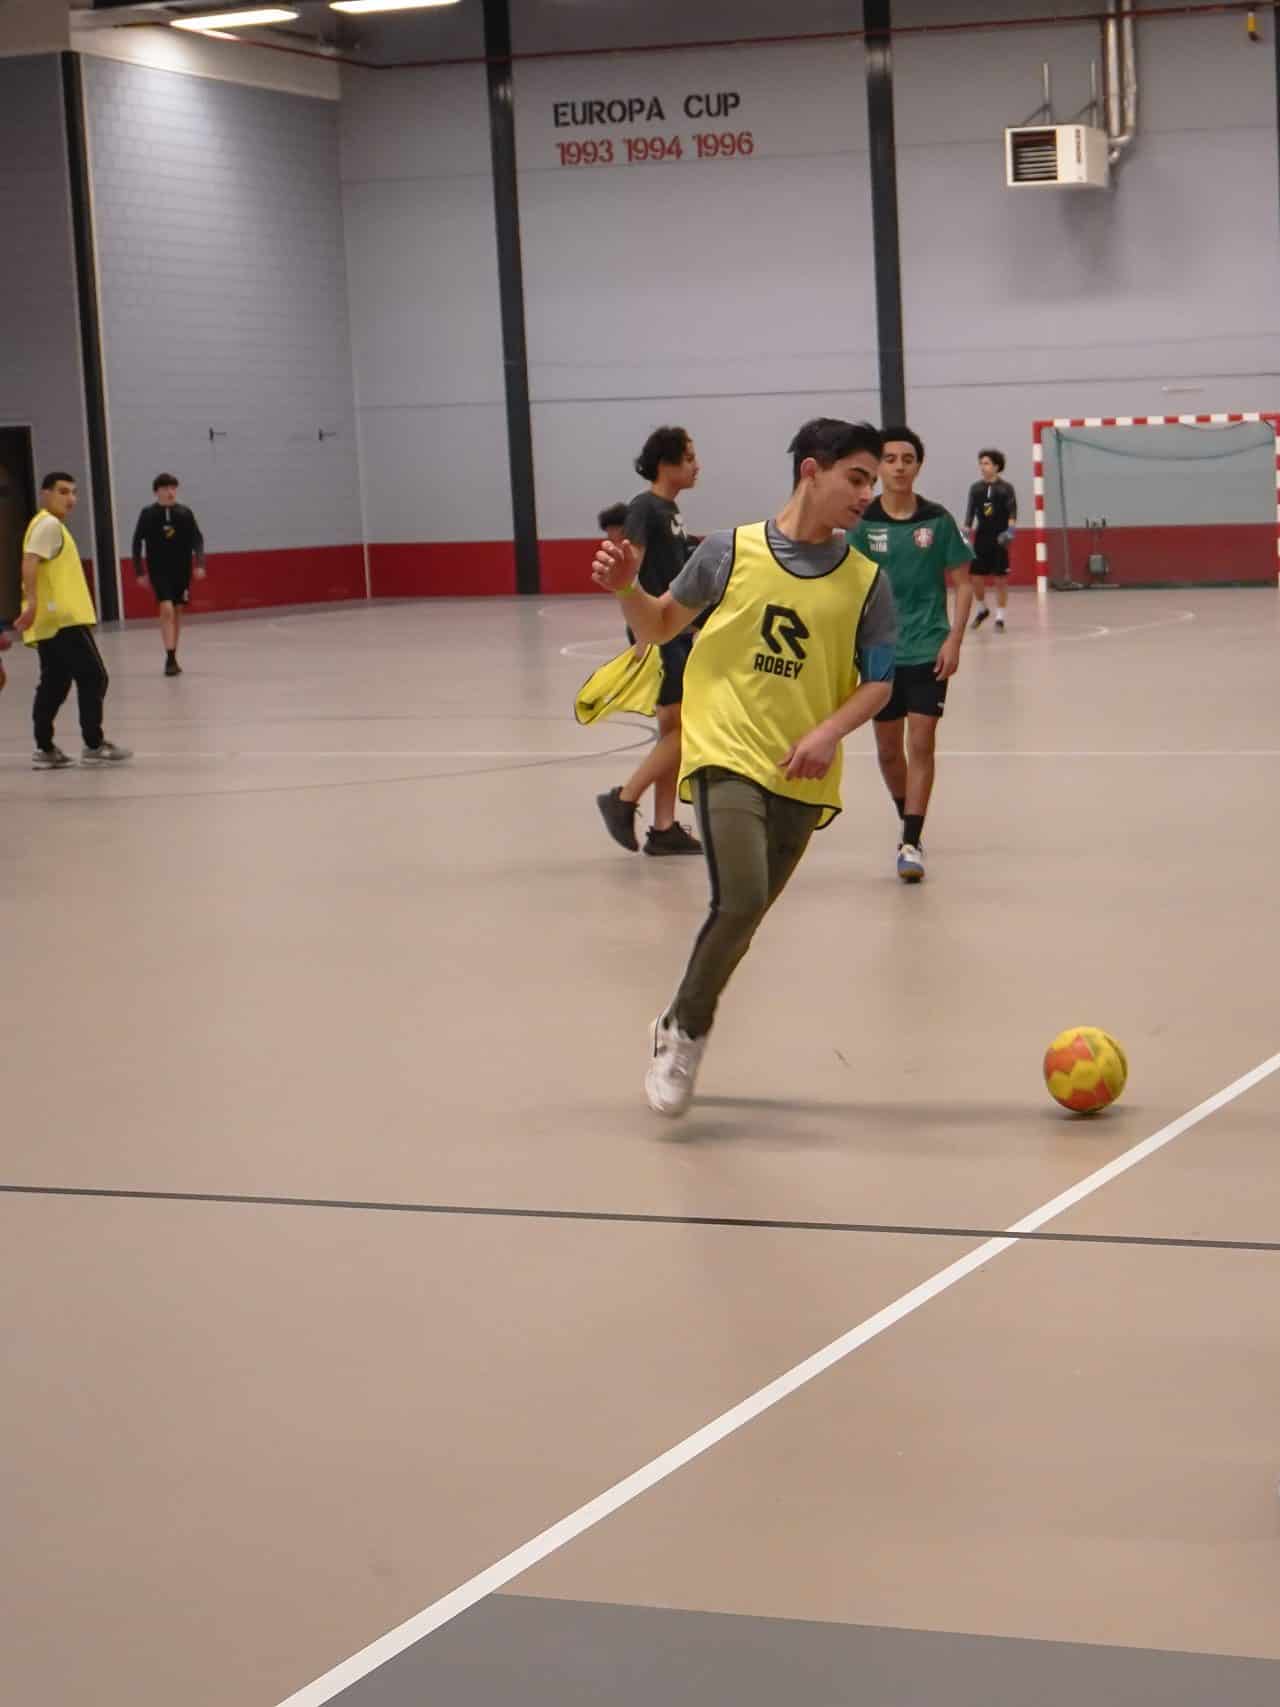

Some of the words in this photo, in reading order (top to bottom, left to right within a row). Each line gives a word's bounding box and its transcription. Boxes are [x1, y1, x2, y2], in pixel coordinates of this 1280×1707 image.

[552, 96, 666, 128] EUROPA
[684, 92, 741, 119] CUP
[556, 138, 615, 167] 1993
[622, 135, 684, 163] 1994
[692, 131, 754, 159] 1996
[753, 652, 804, 680] ROBEY
